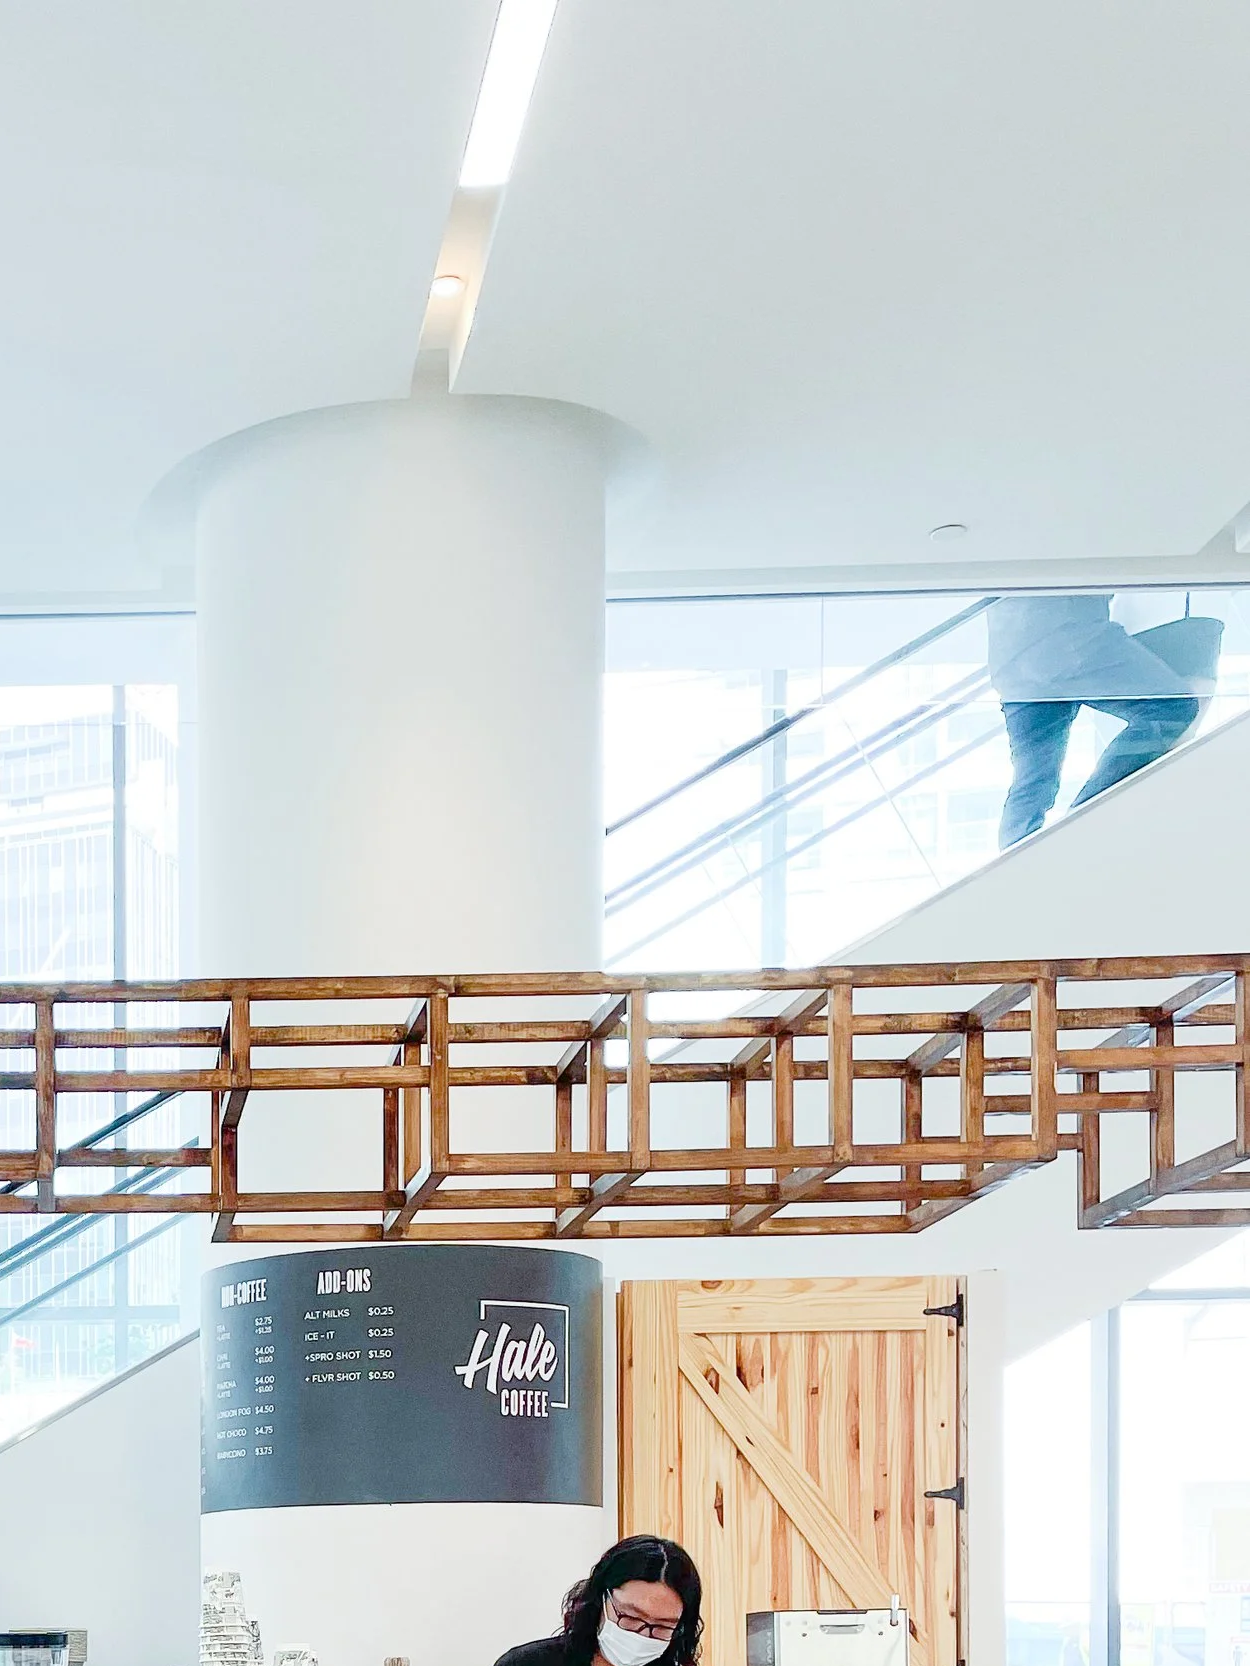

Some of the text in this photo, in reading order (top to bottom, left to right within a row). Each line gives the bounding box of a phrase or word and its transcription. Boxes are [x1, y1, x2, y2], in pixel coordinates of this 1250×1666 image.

[317, 1268, 371, 1295] ADD-ONS
[304, 1306, 394, 1320] ALT MILKS $0.25
[255, 1316, 273, 1326] $2.75
[304, 1332, 319, 1341] ICE
[326, 1331, 335, 1340] IT
[367, 1328, 394, 1338] $0.25
[255, 1345, 275, 1355] $4.00
[305, 1349, 392, 1362] +SPRO SHOT $1.50
[454, 1322, 559, 1395] Hale
[255, 1375, 275, 1385] $4.00
[312, 1373, 334, 1383] FLVR
[336, 1372, 362, 1382] SHOT
[368, 1371, 395, 1380] $0.50
[500, 1389, 549, 1418] COFFEE
[255, 1405, 275, 1415] $4.50
[254, 1425, 273, 1435] $4.75
[254, 1446, 273, 1456] $3.75
